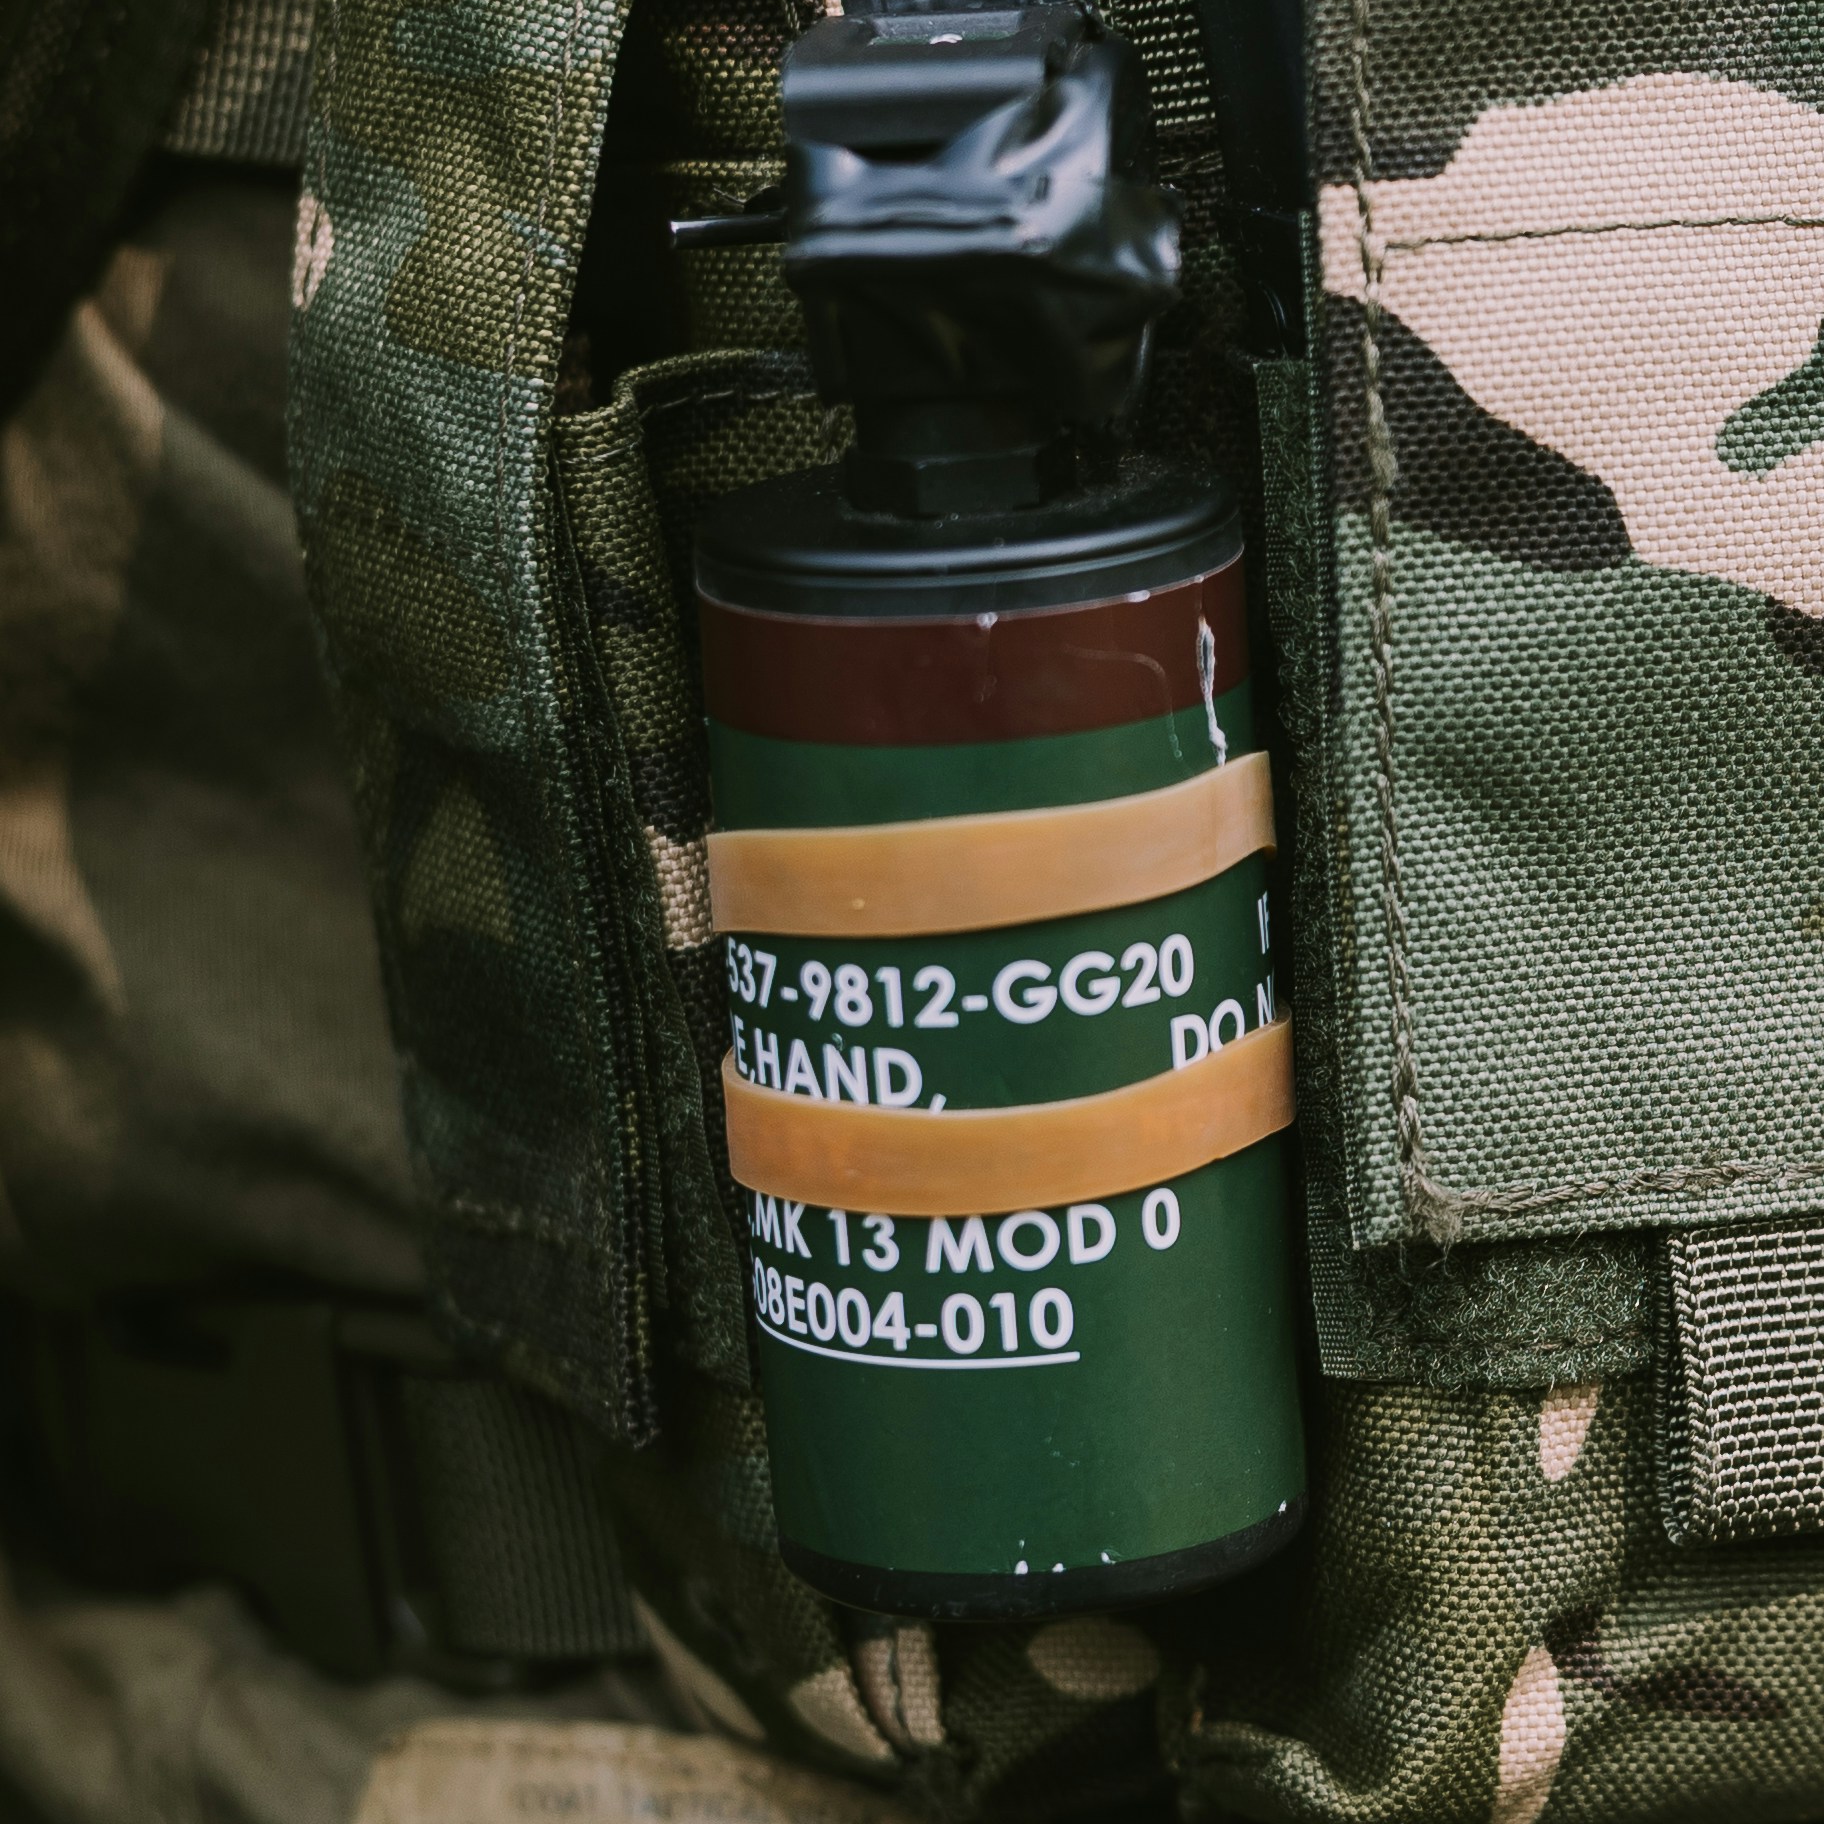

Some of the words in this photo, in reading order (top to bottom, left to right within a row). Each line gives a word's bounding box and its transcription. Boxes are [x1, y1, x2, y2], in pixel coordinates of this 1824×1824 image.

[732, 1014, 948, 1114] E,HAND,
[1170, 998, 1246, 1071] DO
[1257, 974, 1276, 1029] N
[827, 1209, 900, 1272] 13
[925, 1203, 1117, 1273] MOD
[1141, 1187, 1181, 1251] 0
[753, 1256, 1075, 1355] 08E004-010
